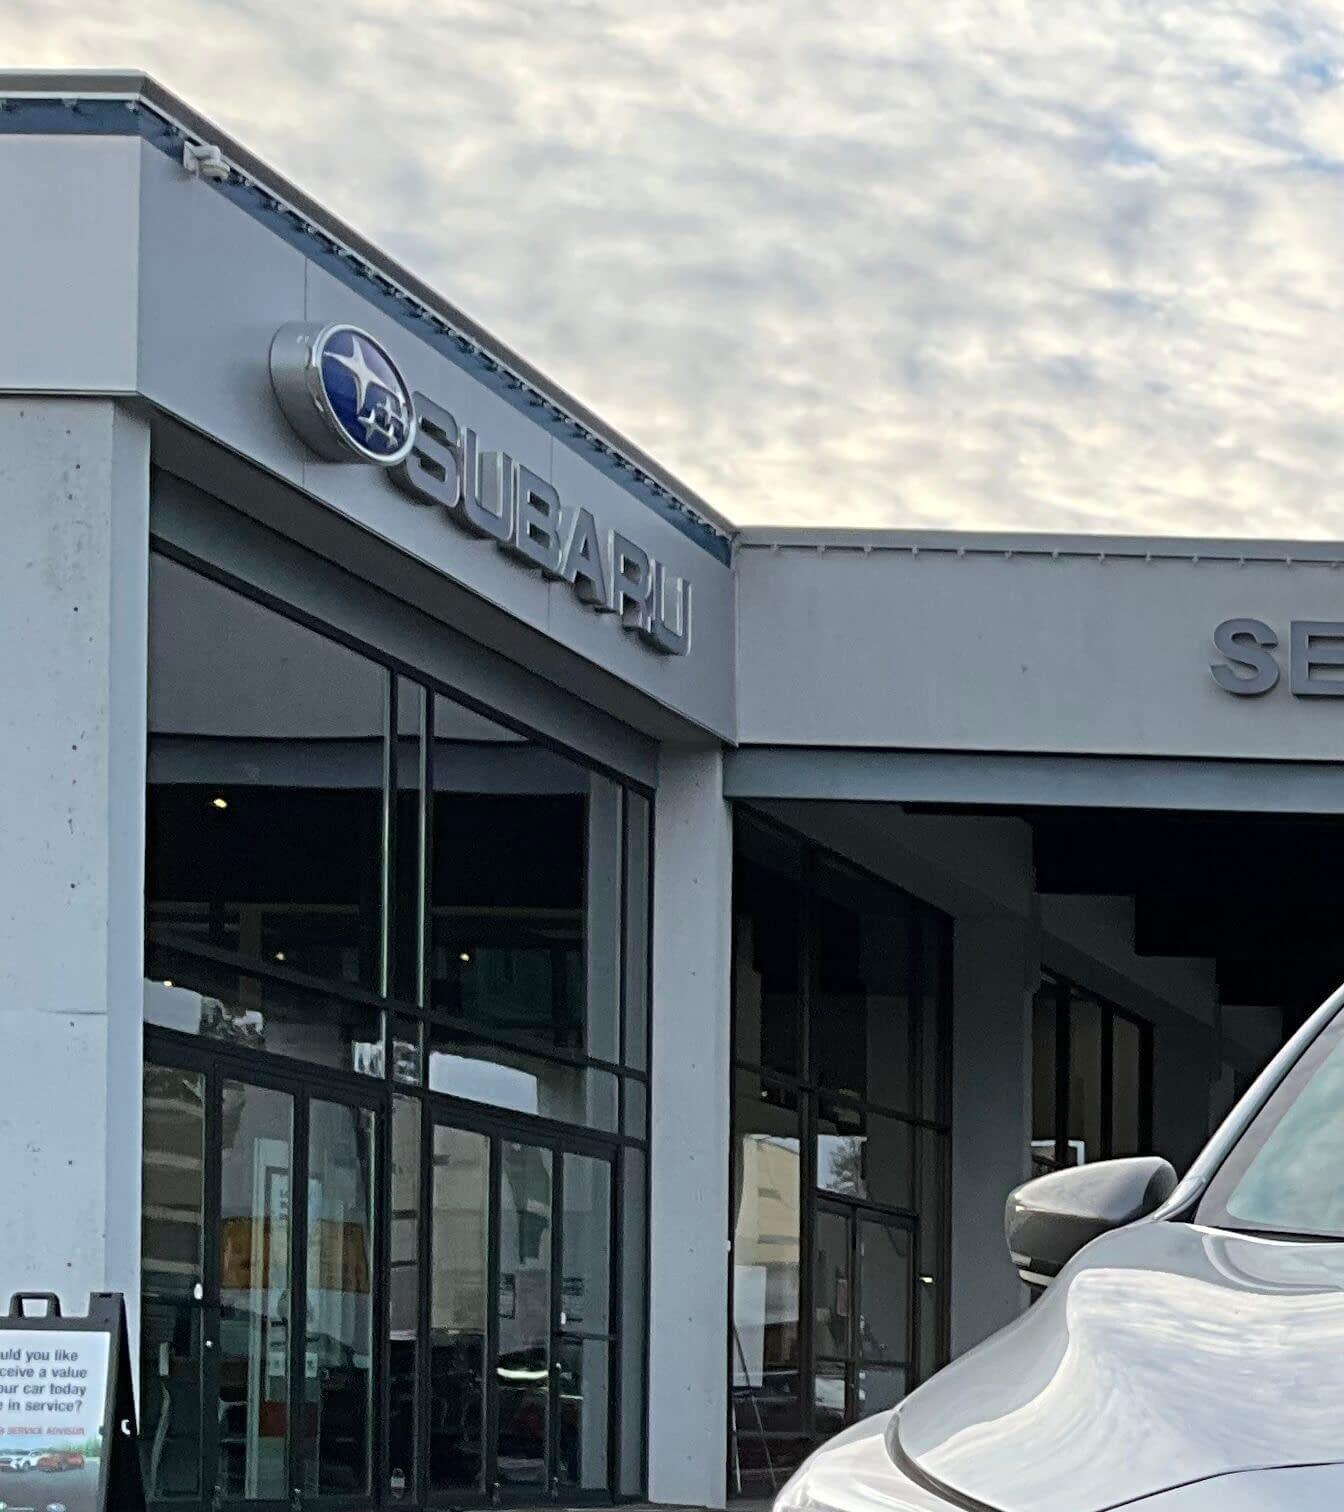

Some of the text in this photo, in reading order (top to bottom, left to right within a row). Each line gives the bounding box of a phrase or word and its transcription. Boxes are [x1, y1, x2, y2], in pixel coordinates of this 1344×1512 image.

[403, 390, 692, 657] SUBARU
[25, 1351, 50, 1363] you
[54, 1349, 79, 1361] like
[39, 1368, 47, 1378] a
[51, 1366, 88, 1379] value
[23, 1384, 45, 1395] car
[49, 1383, 87, 1397] today
[8, 1399, 20, 1411] in
[25, 1399, 83, 1413] service?
